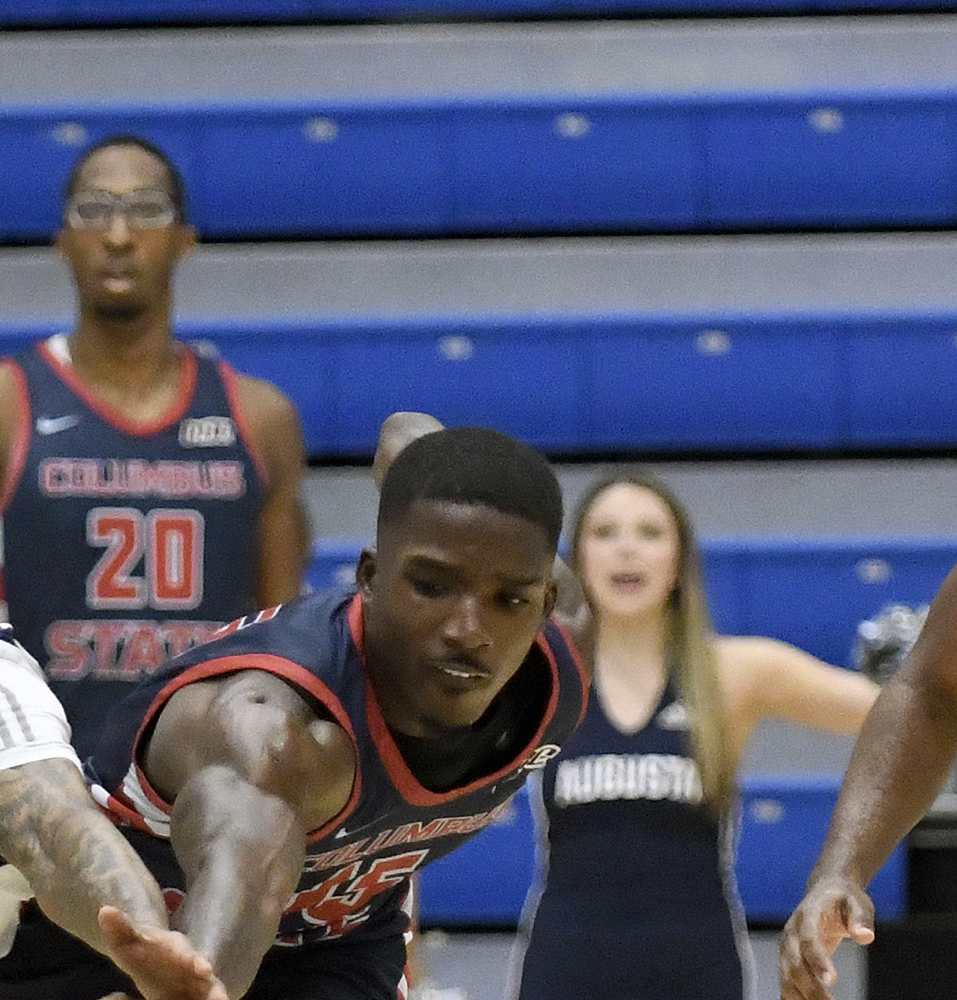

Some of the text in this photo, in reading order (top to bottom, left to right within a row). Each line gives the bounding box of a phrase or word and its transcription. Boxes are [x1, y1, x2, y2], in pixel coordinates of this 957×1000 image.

[40, 459, 245, 498] COLUMBUS
[87, 507, 204, 609] 20
[45, 620, 228, 681] STAT
[555, 754, 703, 806] AUGUSTA
